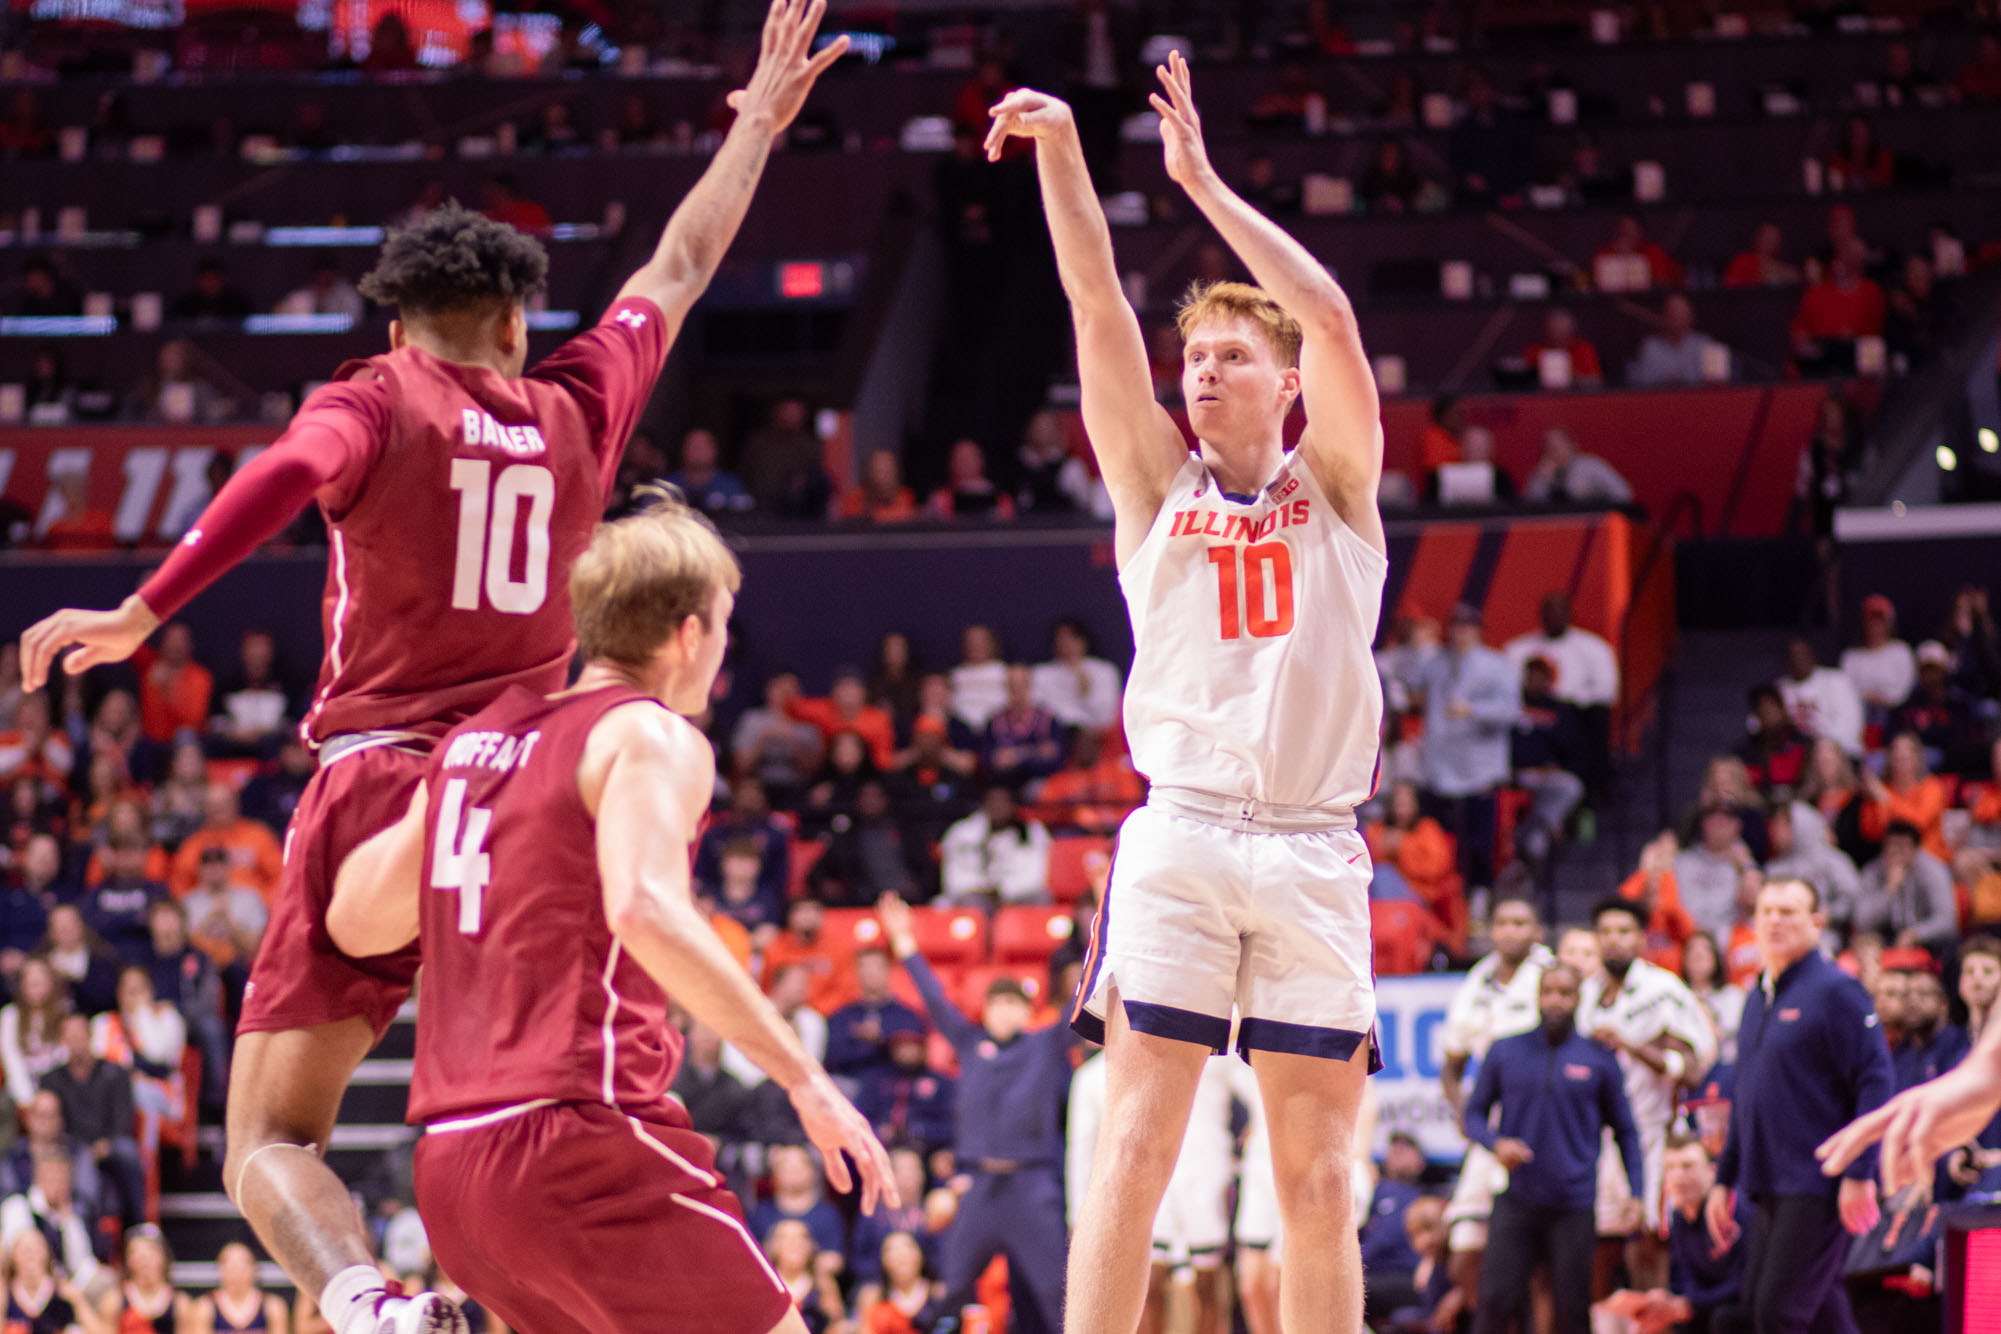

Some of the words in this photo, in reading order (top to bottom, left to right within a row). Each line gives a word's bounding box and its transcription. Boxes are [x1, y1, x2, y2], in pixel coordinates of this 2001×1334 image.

[450, 458, 555, 615] 10
[1169, 499, 1310, 543] ILLINOIS
[1208, 541, 1295, 640] 10
[430, 778, 492, 932] 4
